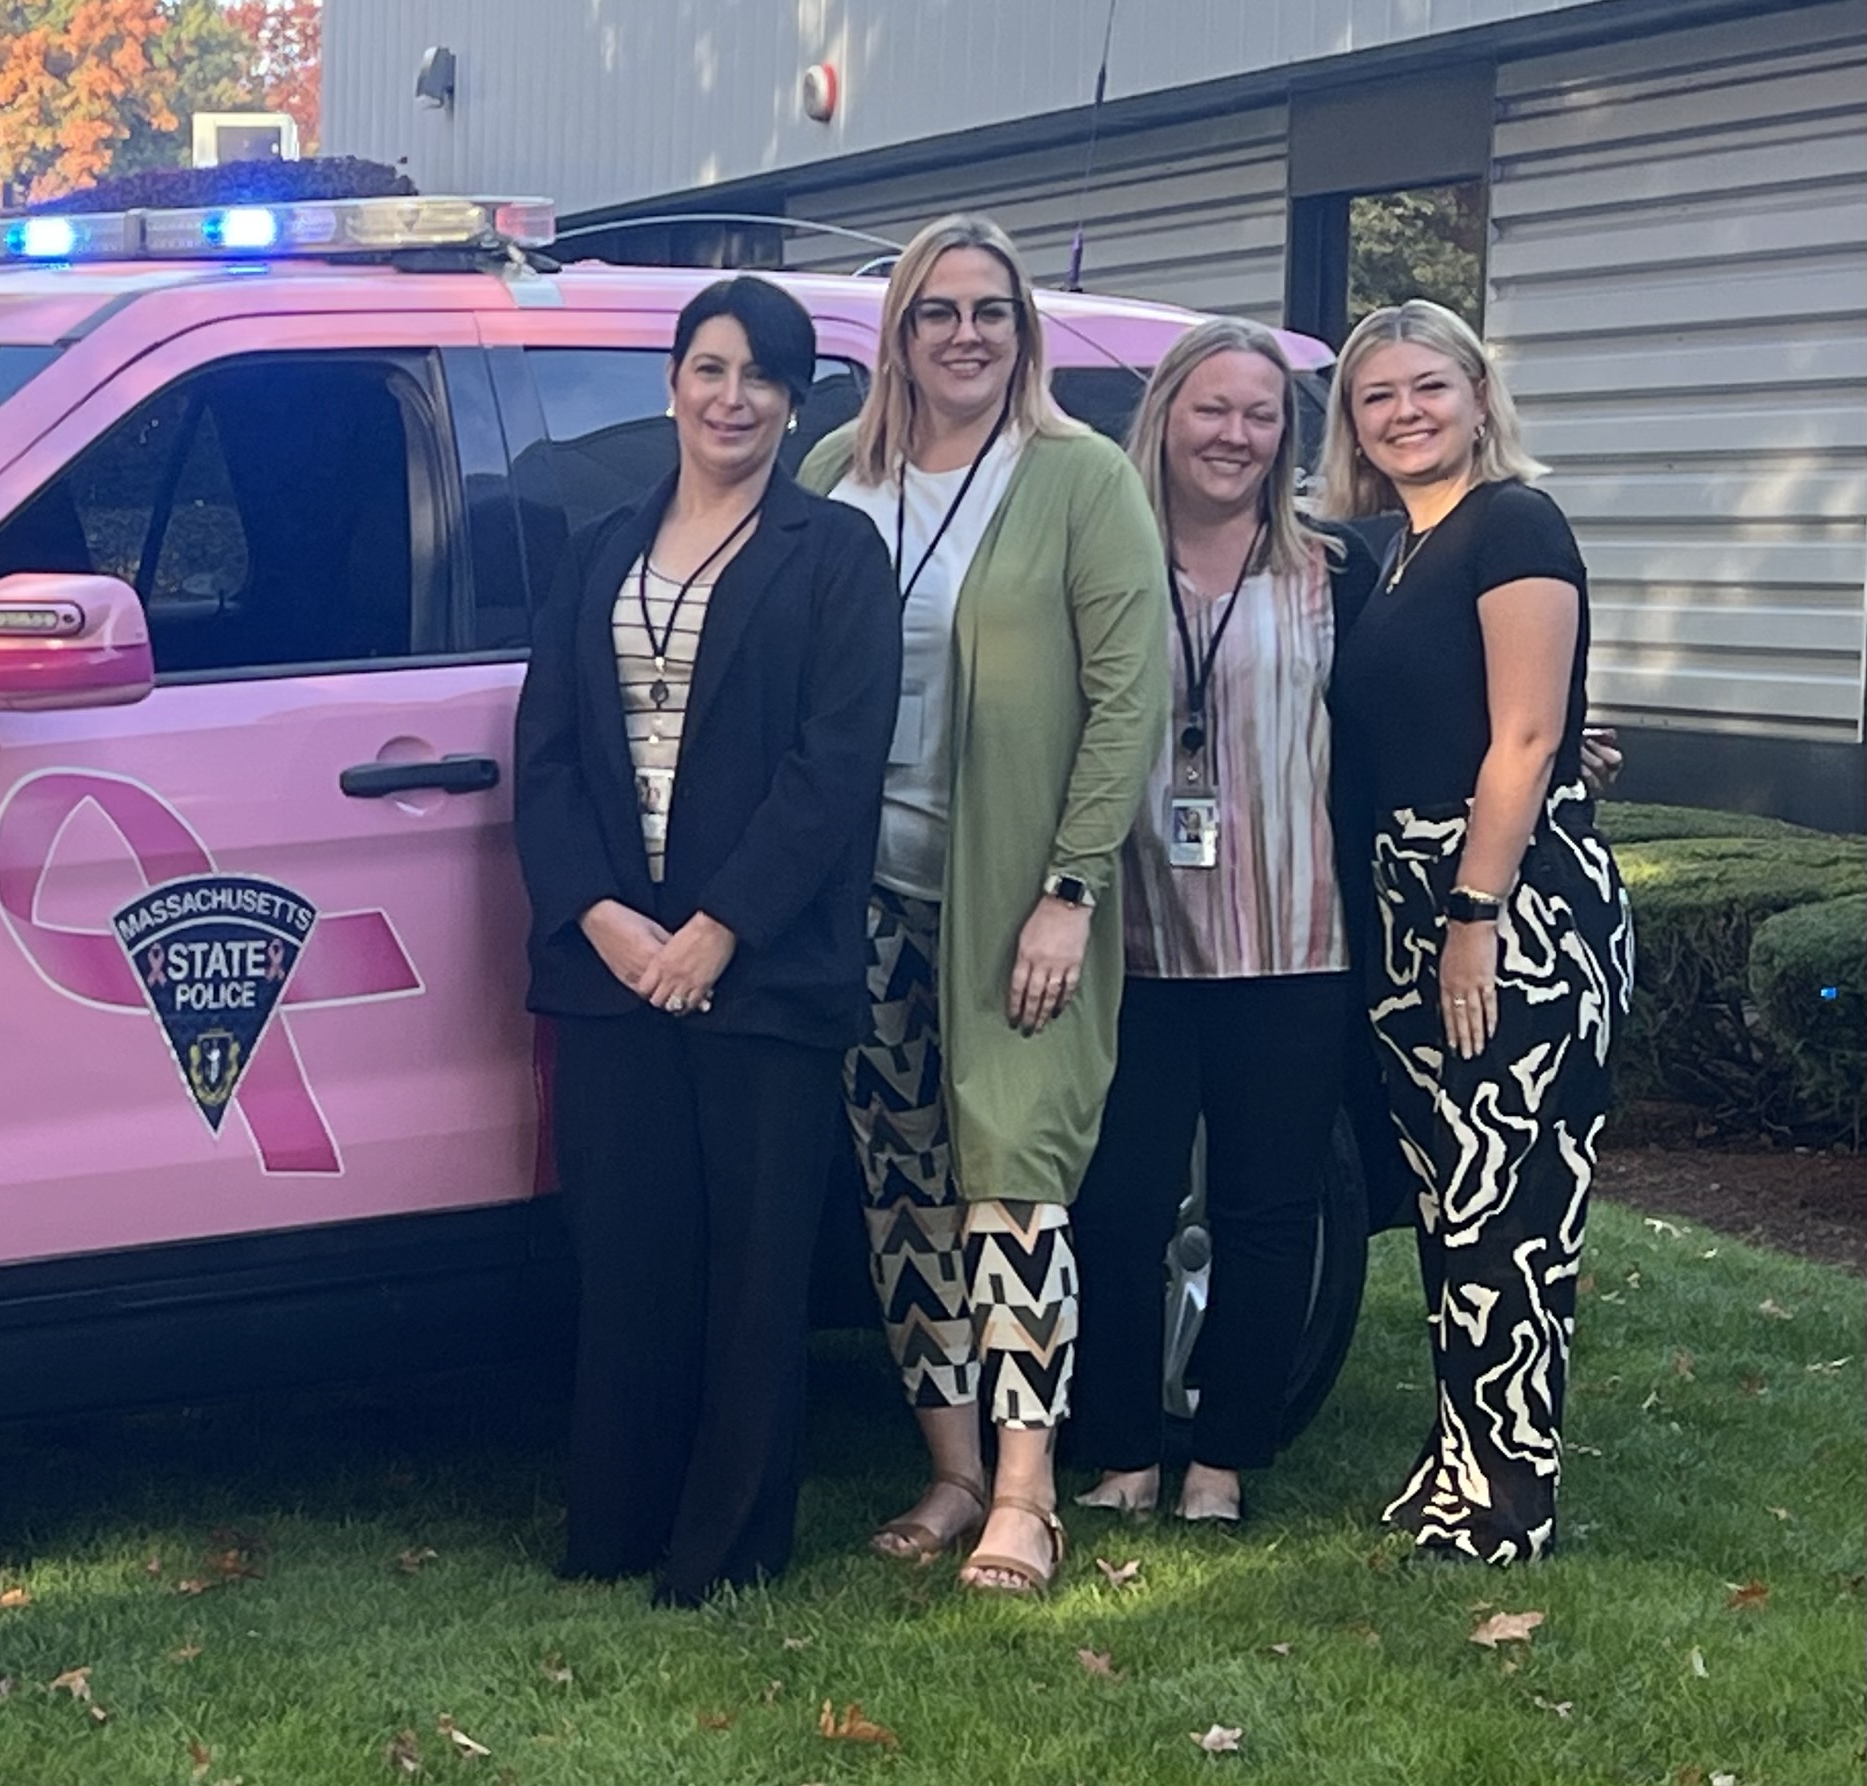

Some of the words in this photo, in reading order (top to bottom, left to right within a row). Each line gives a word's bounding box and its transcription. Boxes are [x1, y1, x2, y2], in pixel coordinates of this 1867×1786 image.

[117, 887, 314, 942] MASSACHUSETTS
[167, 940, 267, 982] STATE
[175, 981, 257, 1011] POLICE
